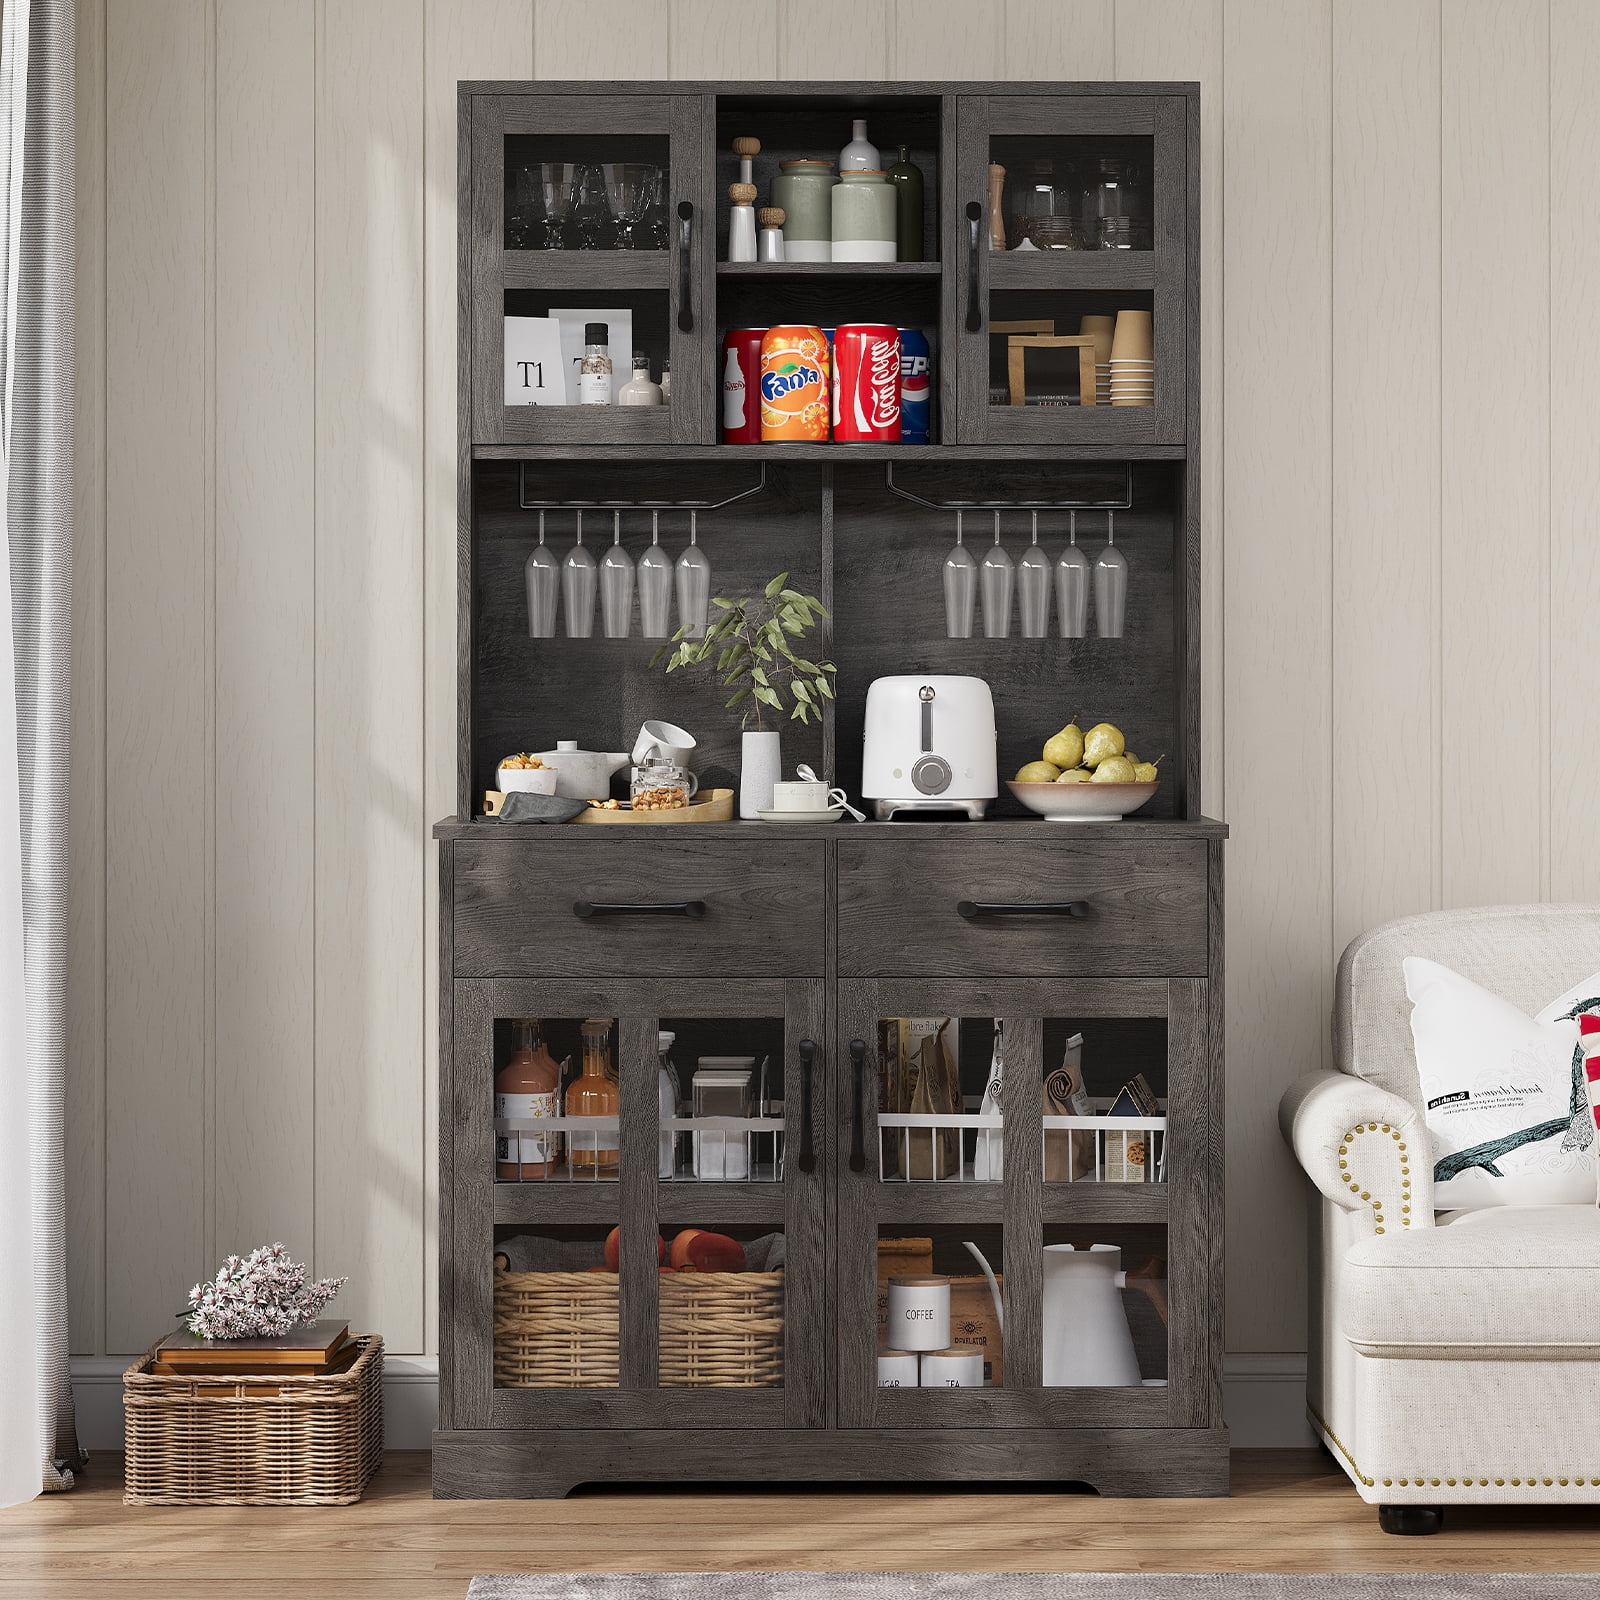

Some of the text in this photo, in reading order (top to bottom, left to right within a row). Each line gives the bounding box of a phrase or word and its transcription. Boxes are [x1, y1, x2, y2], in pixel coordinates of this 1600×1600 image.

[901, 356, 930, 377] EP
[761, 366, 820, 401] Fanta
[925, 1020, 942, 1032] flak
[905, 1309, 934, 1320] COFFEE
[878, 1379, 900, 1388] UGAR
[945, 1379, 961, 1388] TEA
